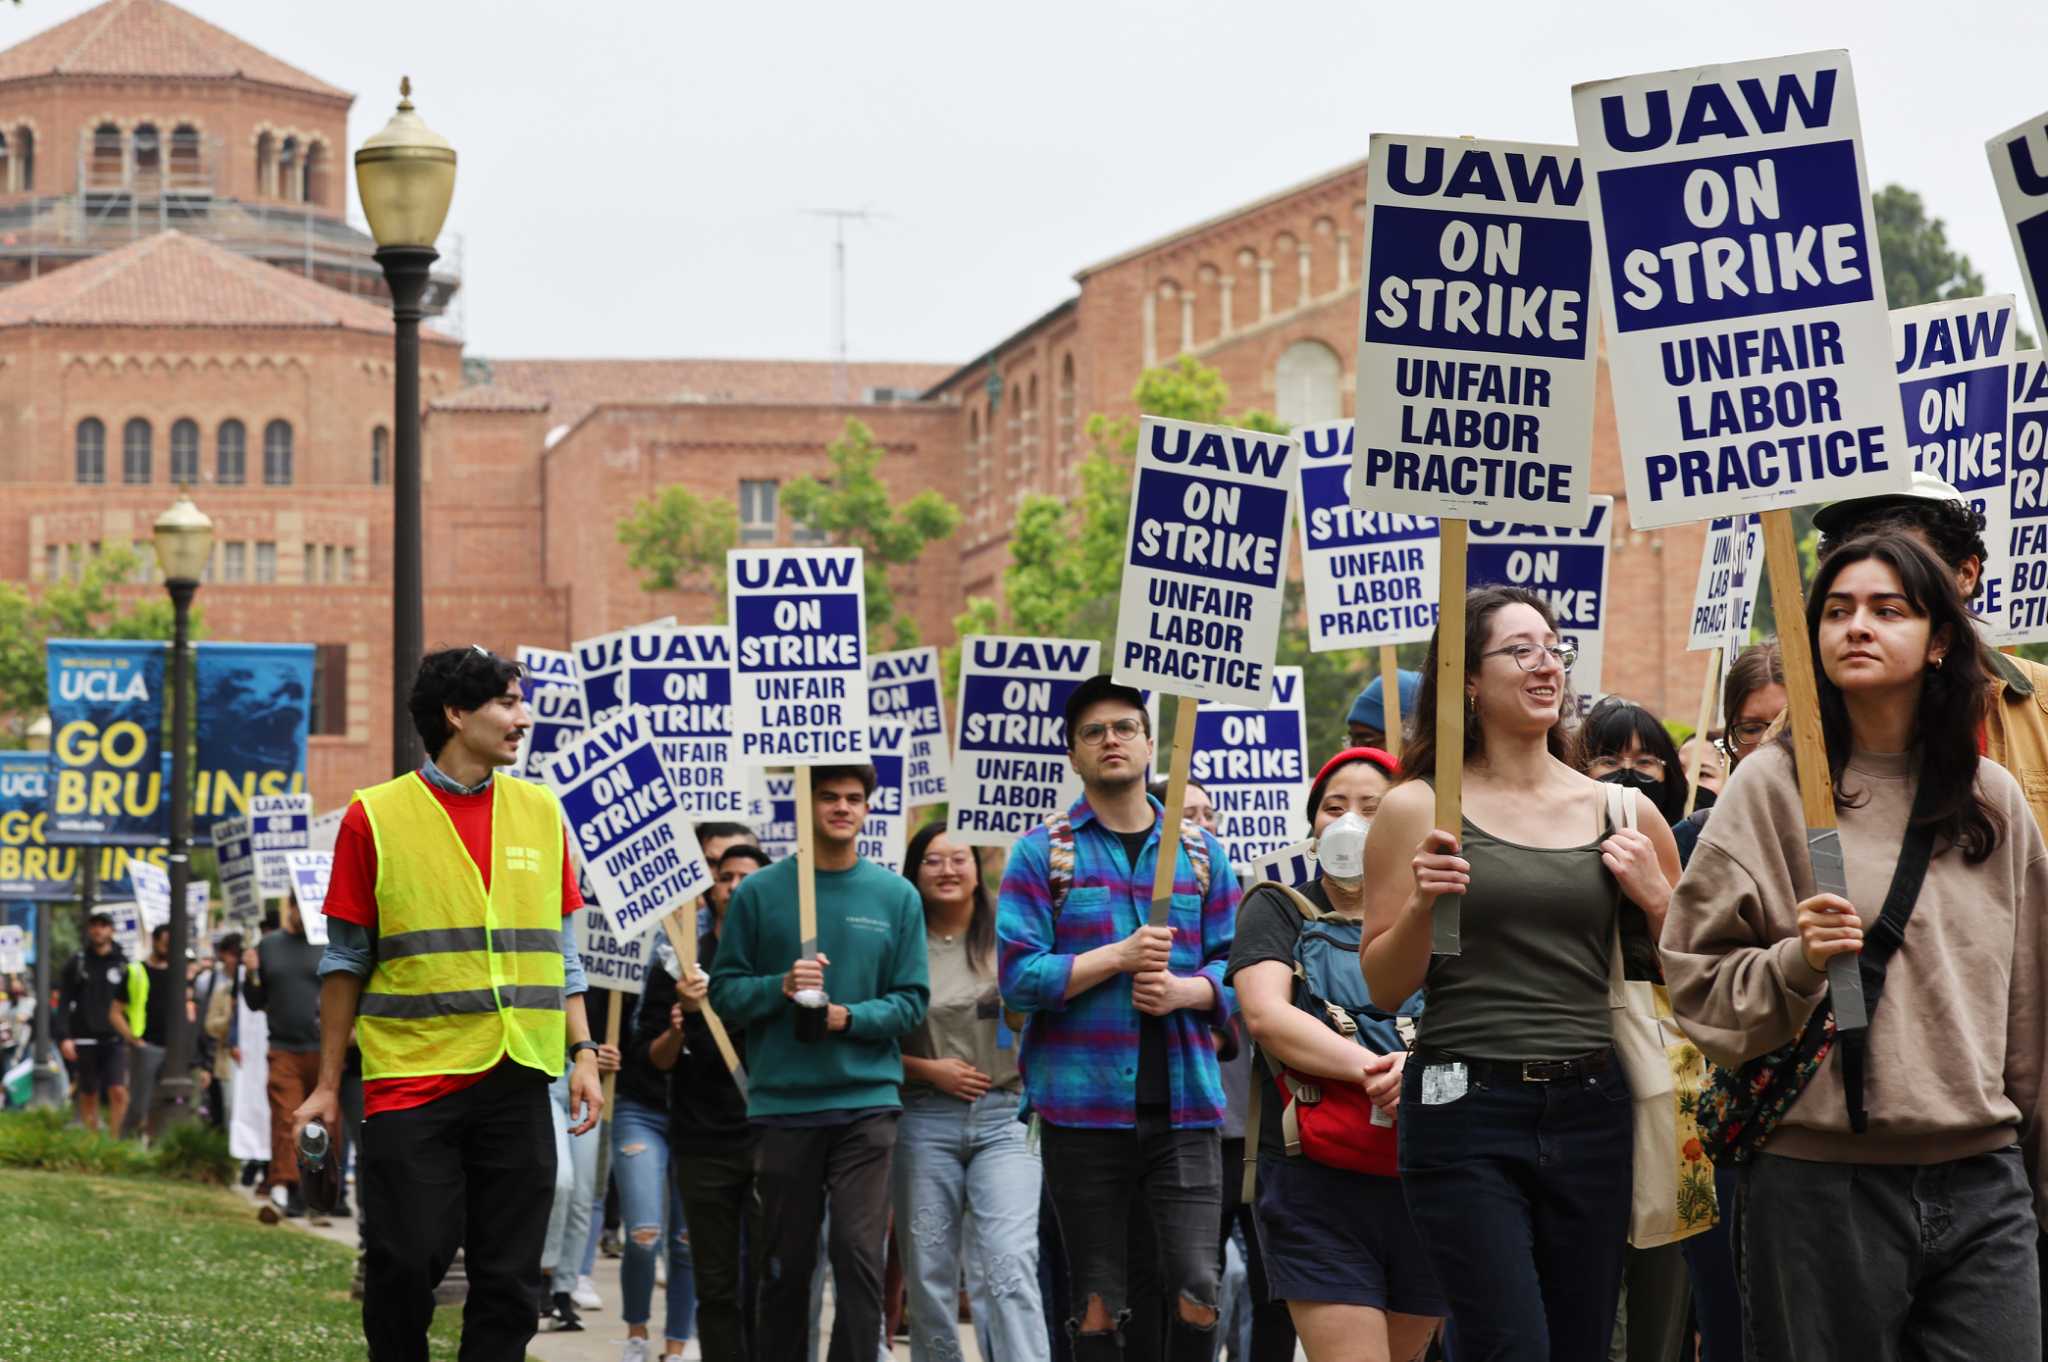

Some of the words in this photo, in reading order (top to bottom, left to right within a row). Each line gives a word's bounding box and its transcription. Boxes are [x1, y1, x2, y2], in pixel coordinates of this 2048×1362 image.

[1601, 69, 1837, 153] UAW
[1387, 144, 1584, 206] UAW
[1684, 159, 1781, 228] ON
[1439, 220, 1522, 276] ON
[1624, 224, 1862, 310] STRIKE
[1375, 275, 1581, 341] STRIKE
[1661, 321, 1844, 386] UNFAIR
[1396, 357, 1551, 407] UNFAIR
[1678, 377, 1841, 440] LABOR
[1919, 382, 1966, 434] ON
[1401, 405, 1540, 453] LABOR
[1151, 425, 1290, 478] UAW
[1646, 426, 1889, 501] PRACTICE
[1366, 449, 1572, 503] PRACTICE
[1183, 482, 1241, 525] ON
[1138, 518, 1278, 575] STRIKE
[1330, 548, 1424, 579] UNFAIR
[737, 557, 855, 589] UAW
[1506, 550, 1559, 584] ON
[1149, 578, 1253, 621] UNFAIR
[1338, 576, 1422, 606] LABOR
[1708, 570, 1730, 599] LAB
[774, 599, 821, 631] ON
[631, 635, 730, 662] UAW
[1150, 612, 1243, 653] LABOR
[527, 653, 577, 676] UA
[740, 633, 858, 667] STRIKE
[974, 641, 1091, 672] UAW
[1124, 641, 1263, 691] PRACTICE
[872, 654, 929, 682] AW
[59, 670, 150, 701] UCLA
[663, 672, 707, 701] ON
[756, 677, 845, 700] UNFAIR
[872, 684, 910, 712] ON
[1003, 680, 1051, 712] ON
[538, 695, 583, 719] UA
[762, 704, 841, 727] LABOR
[56, 720, 147, 768] GO
[743, 730, 862, 754] PRACTICE
[965, 712, 1068, 747] STRIK
[1222, 715, 1266, 745] ON
[551, 713, 640, 785] UAW
[661, 743, 728, 763] NFAIR
[1192, 749, 1300, 780] STRIKE
[1, 774, 48, 798] UCL
[591, 762, 634, 806] ON
[976, 758, 1064, 783] UNFAIR
[55, 770, 162, 817] BRU
[254, 798, 306, 812] UAW
[680, 791, 742, 811] CTICE
[978, 784, 1057, 809] LABOR
[579, 776, 673, 853] STRIKE
[0, 847, 76, 881] BRU
[605, 823, 674, 877] UNFAIR
[618, 847, 680, 898] LABOR
[615, 860, 704, 930] PRACTICE
